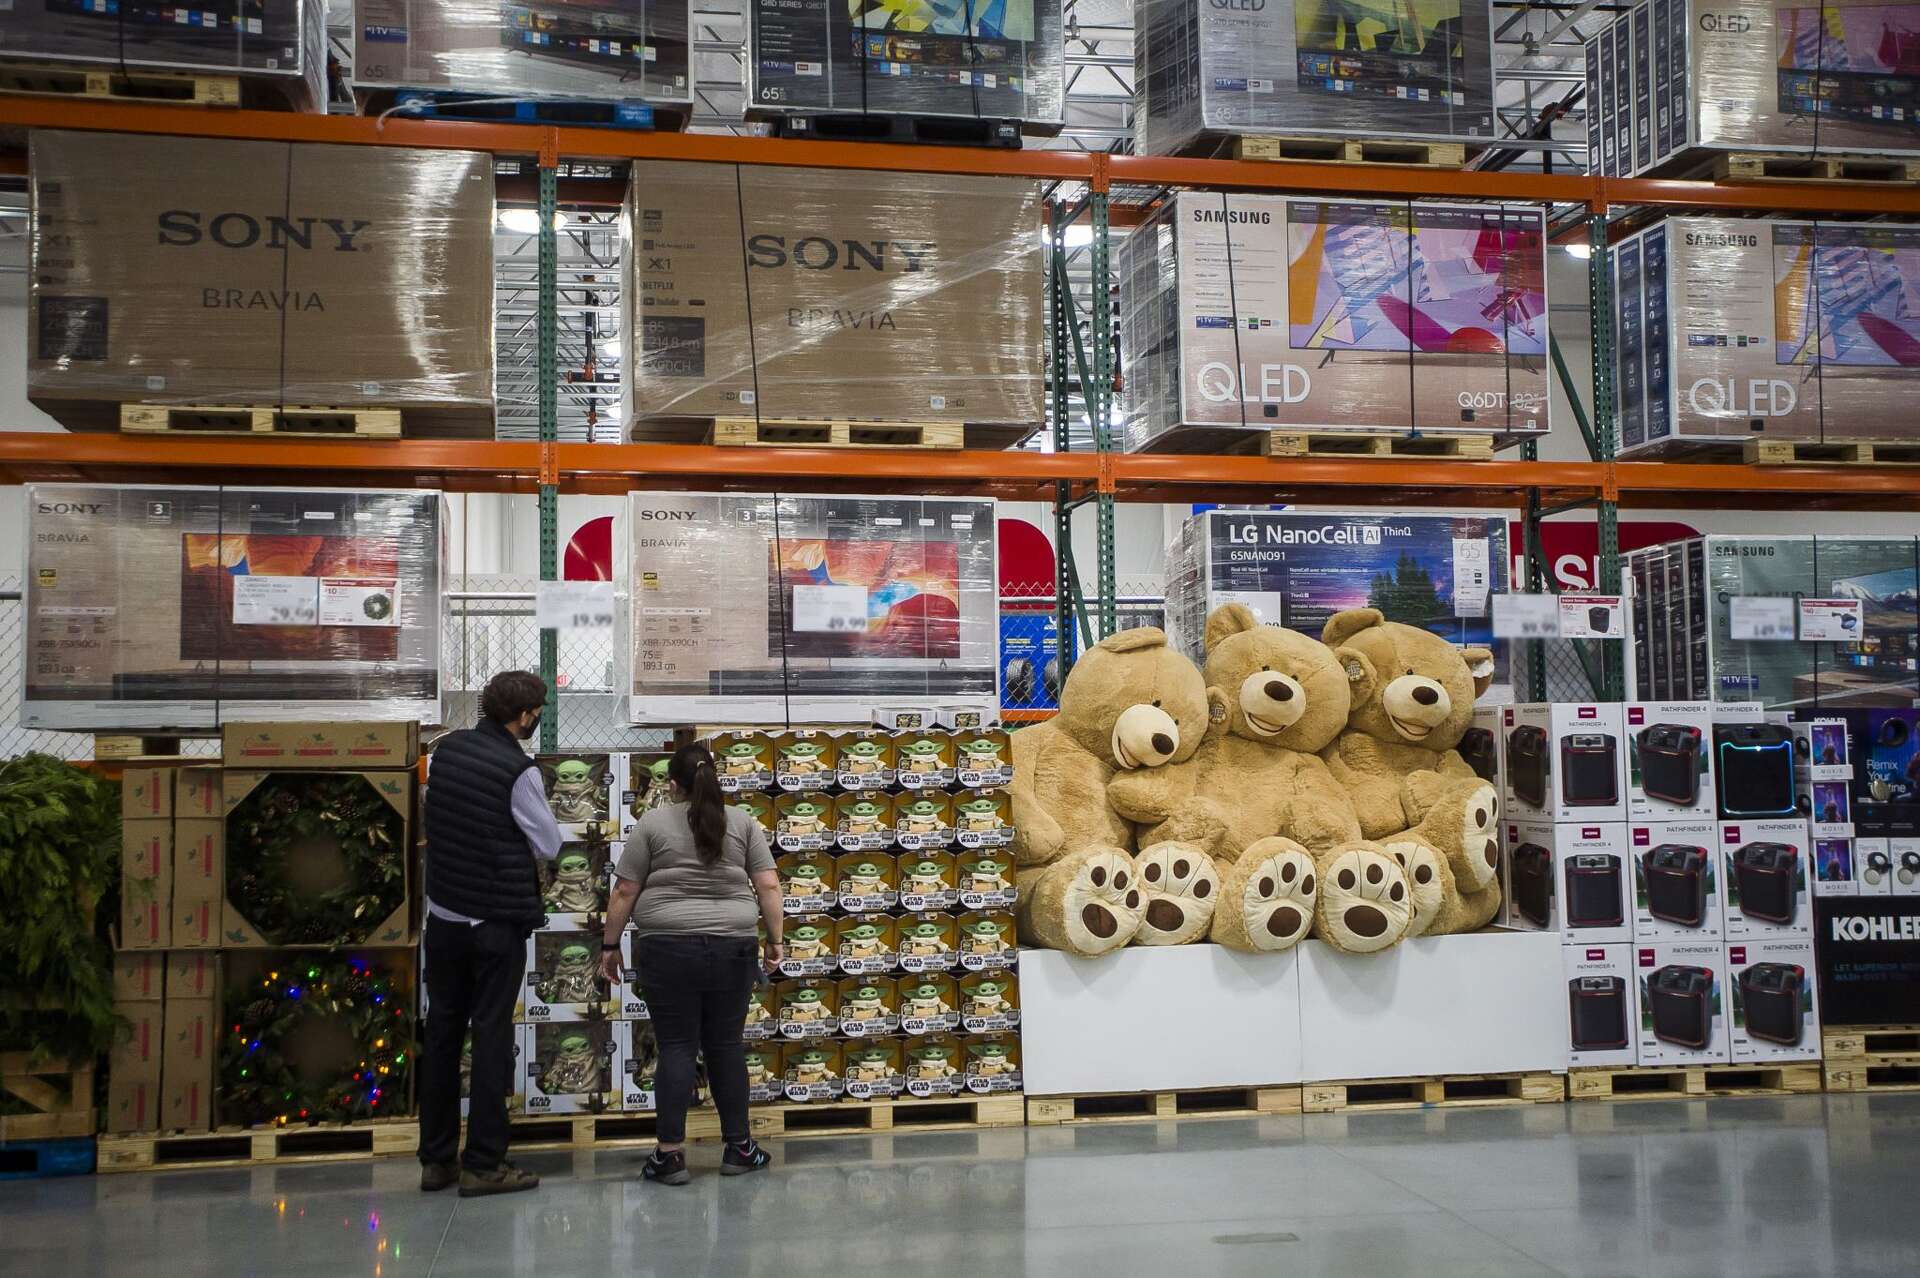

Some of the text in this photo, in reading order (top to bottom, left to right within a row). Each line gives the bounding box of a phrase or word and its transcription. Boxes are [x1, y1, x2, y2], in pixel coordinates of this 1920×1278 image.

[1700, 13, 1750, 32] QLED
[364, 66, 383, 78] 65
[762, 87, 779, 100] 65
[1194, 209, 1270, 225] SAMSUNG
[157, 210, 371, 252] SONY
[1686, 233, 1757, 247] SAMSUNG
[747, 233, 939, 273] SONY
[642, 281, 674, 290] NETFLIX
[202, 287, 326, 313] BRAVIA
[787, 307, 898, 331] BRAVIA
[1197, 361, 1312, 404] QLED
[1458, 391, 1507, 409] Q6DT
[1689, 377, 1796, 418] QLED
[37, 503, 101, 514] SONY
[154, 504, 164, 514] 3
[641, 510, 697, 521] SONY
[743, 511, 751, 520] 3
[37, 533, 90, 543] BRAVIA
[1229, 525, 1412, 544] LG NanoCell AI ThinQ
[641, 538, 687, 548] BRAVIA
[1230, 550, 1286, 561] 65NANO91
[1460, 542, 1481, 559] 65
[573, 613, 613, 627] 19.99
[827, 617, 866, 630] 49.99
[643, 650, 653, 659] 75
[643, 661, 662, 671] 189.3
[1731, 676, 1741, 684] TV
[1866, 759, 1898, 770] Remix
[1868, 771, 1890, 781] Your
[1867, 782, 1906, 793] tine
[1832, 916, 1920, 941] KOHLER
